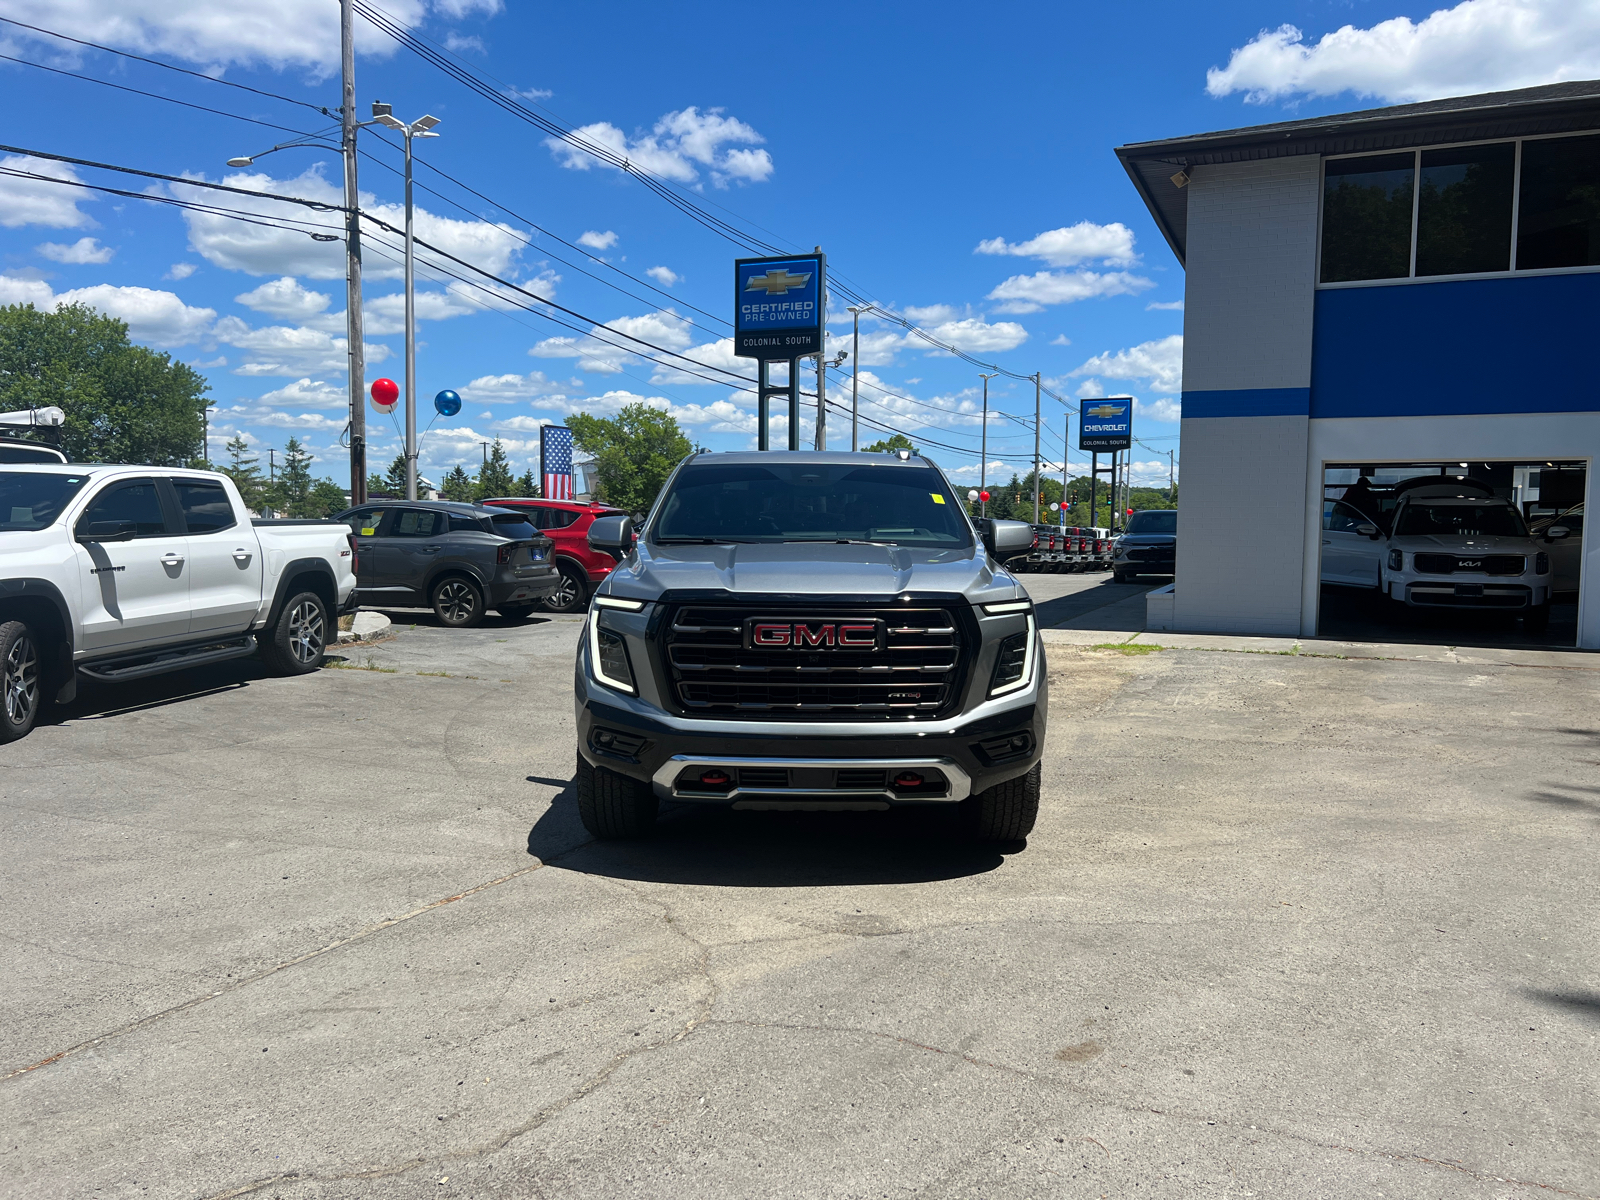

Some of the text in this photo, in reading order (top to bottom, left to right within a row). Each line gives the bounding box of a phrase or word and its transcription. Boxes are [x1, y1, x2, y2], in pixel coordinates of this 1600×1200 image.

[742, 301, 813, 313] CERTIFIED
[745, 311, 810, 321] PRE-OWNED
[743, 336, 811, 347] COLONIAL SOUTH
[753, 623, 875, 646] GMC
